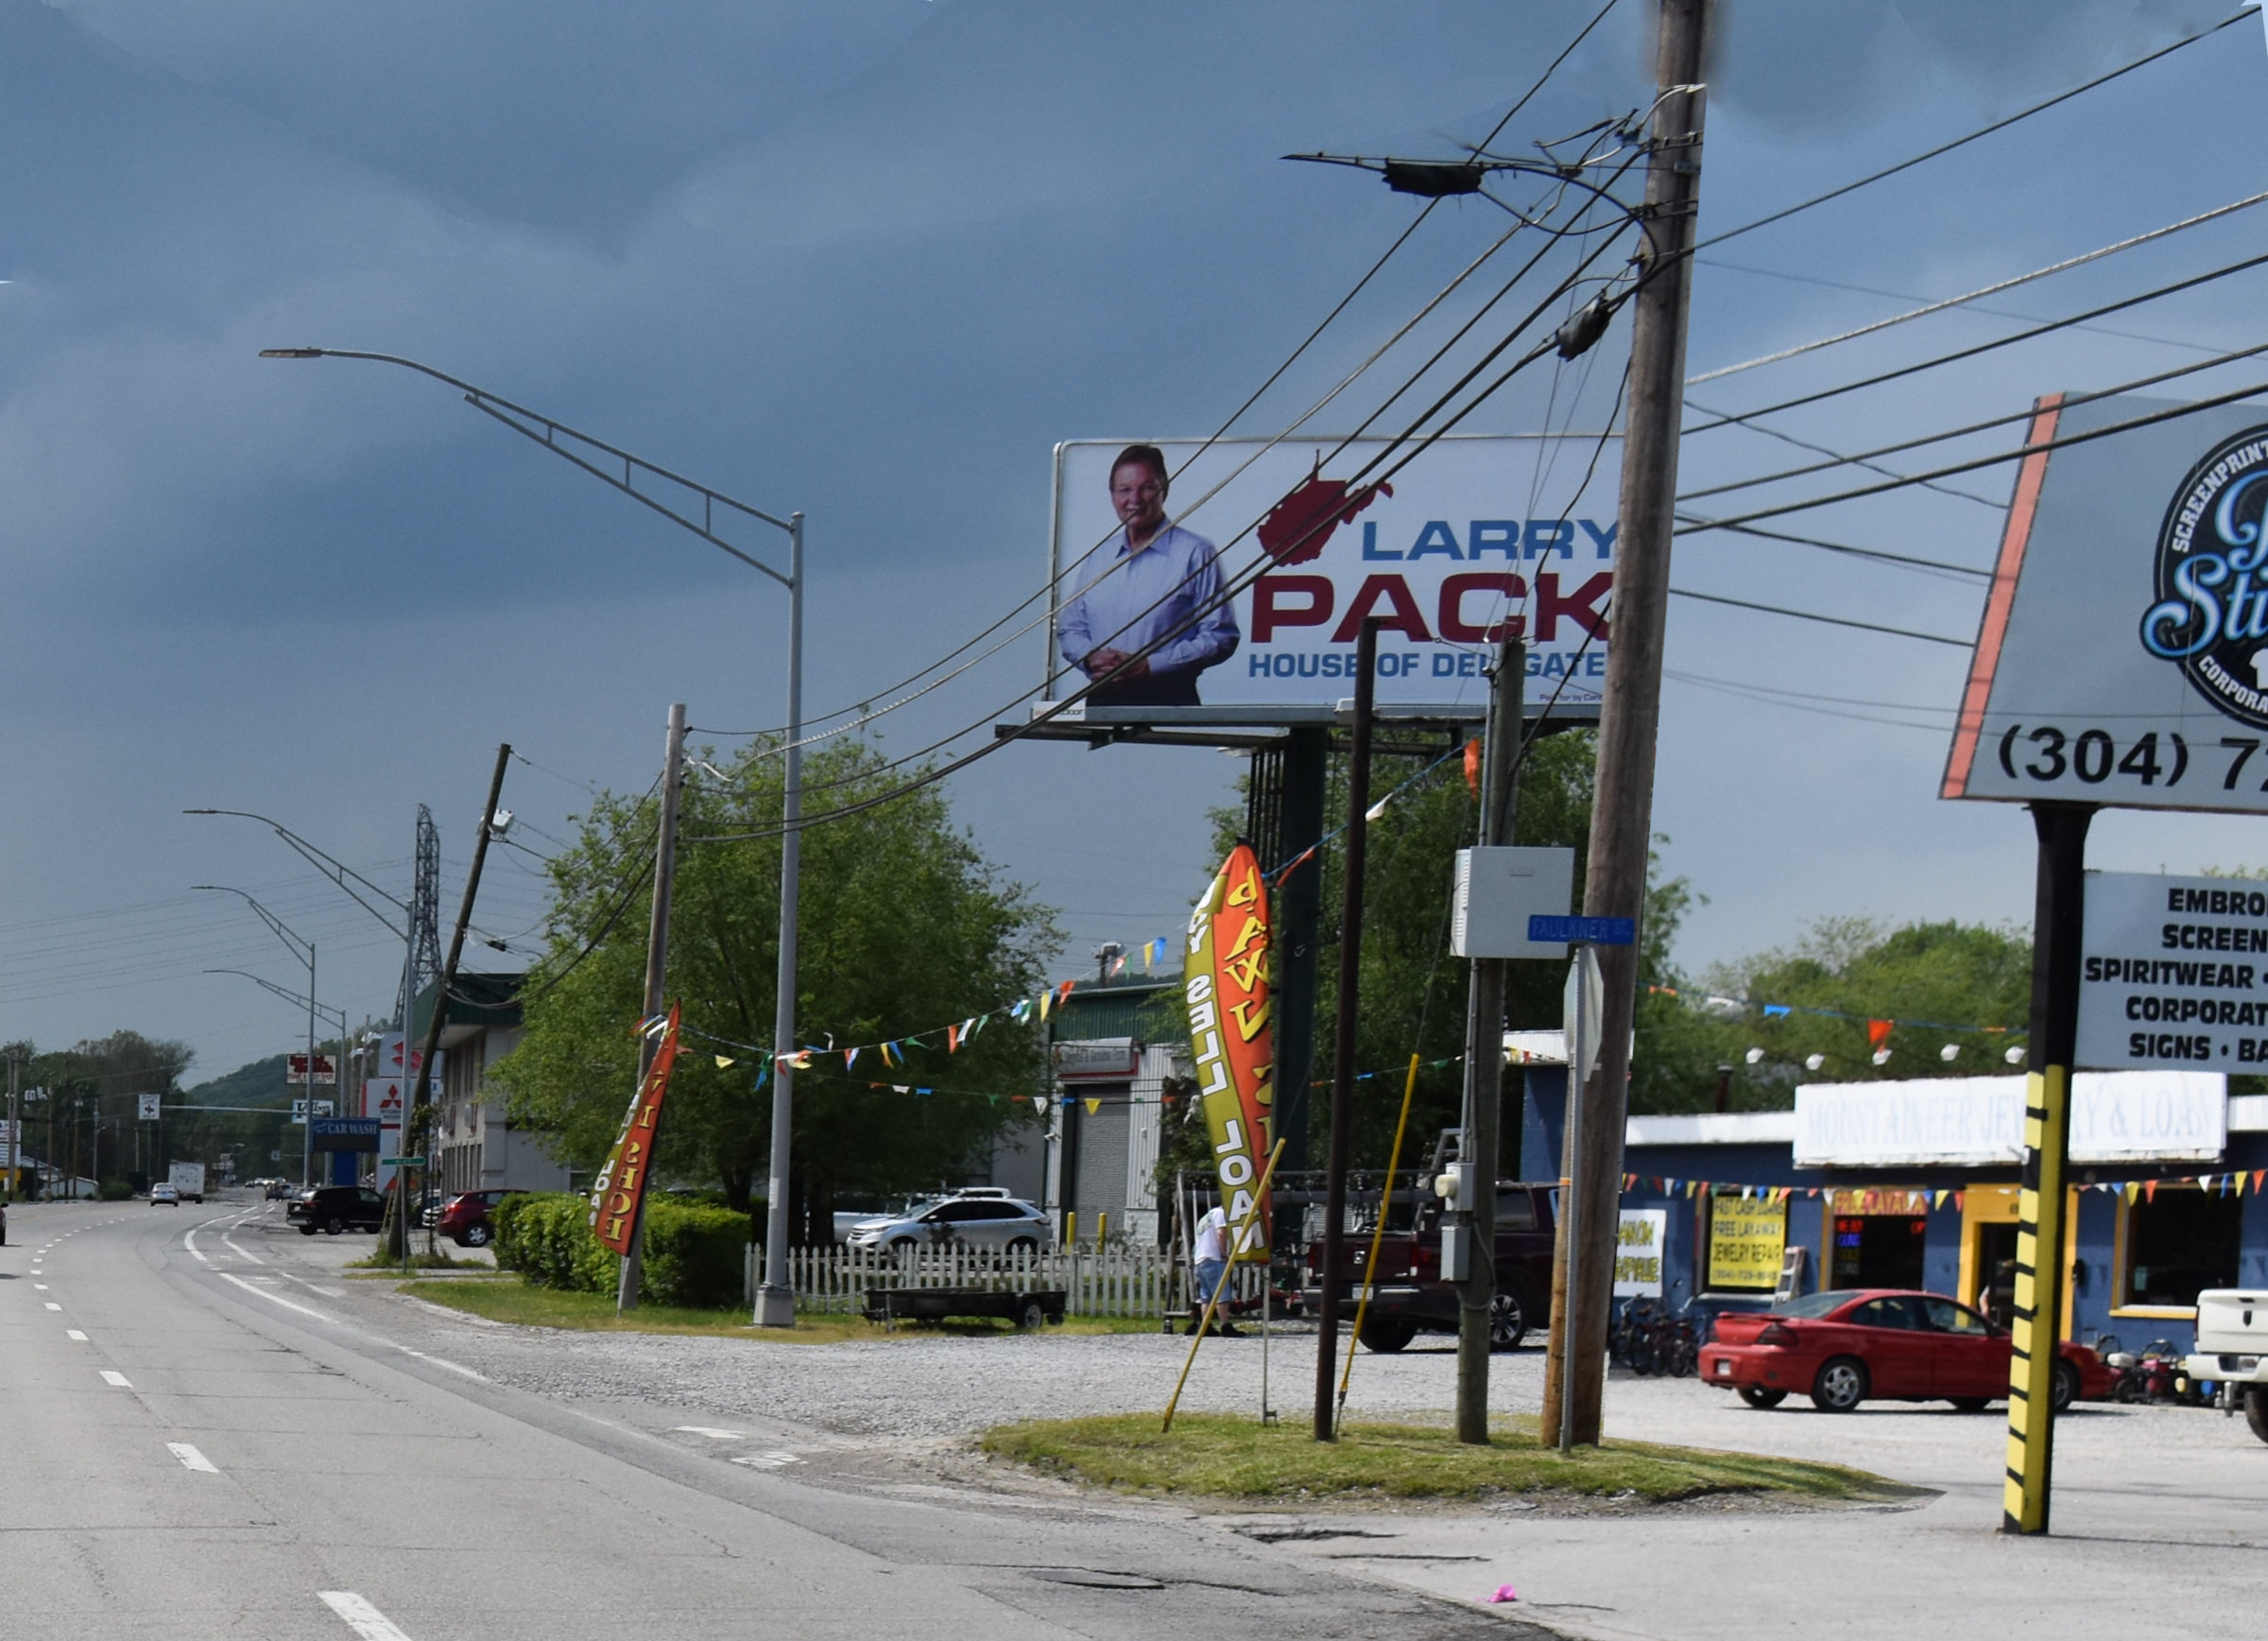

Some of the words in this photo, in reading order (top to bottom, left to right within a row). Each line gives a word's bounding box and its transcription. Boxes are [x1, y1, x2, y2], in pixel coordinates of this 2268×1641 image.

[1362, 519, 1618, 561] LARRY
[1250, 572, 1613, 643] PACK
[1248, 652, 1359, 679] HOUSE
[1377, 652, 1419, 678] OF
[1432, 652, 1606, 678] DELGATE
[1999, 724, 2189, 786] (304)
[2168, 888, 2268, 917] EMBRO
[1532, 918, 1608, 939] FAULKNER
[2162, 924, 2268, 954] SCREEN
[2085, 957, 2254, 989] SPIRITWEAR
[2129, 1032, 2210, 1060] SIGNS
[328, 1124, 349, 1134] CAR
[351, 1124, 377, 1134] WASH
[1714, 1220, 1736, 1237] FREE
